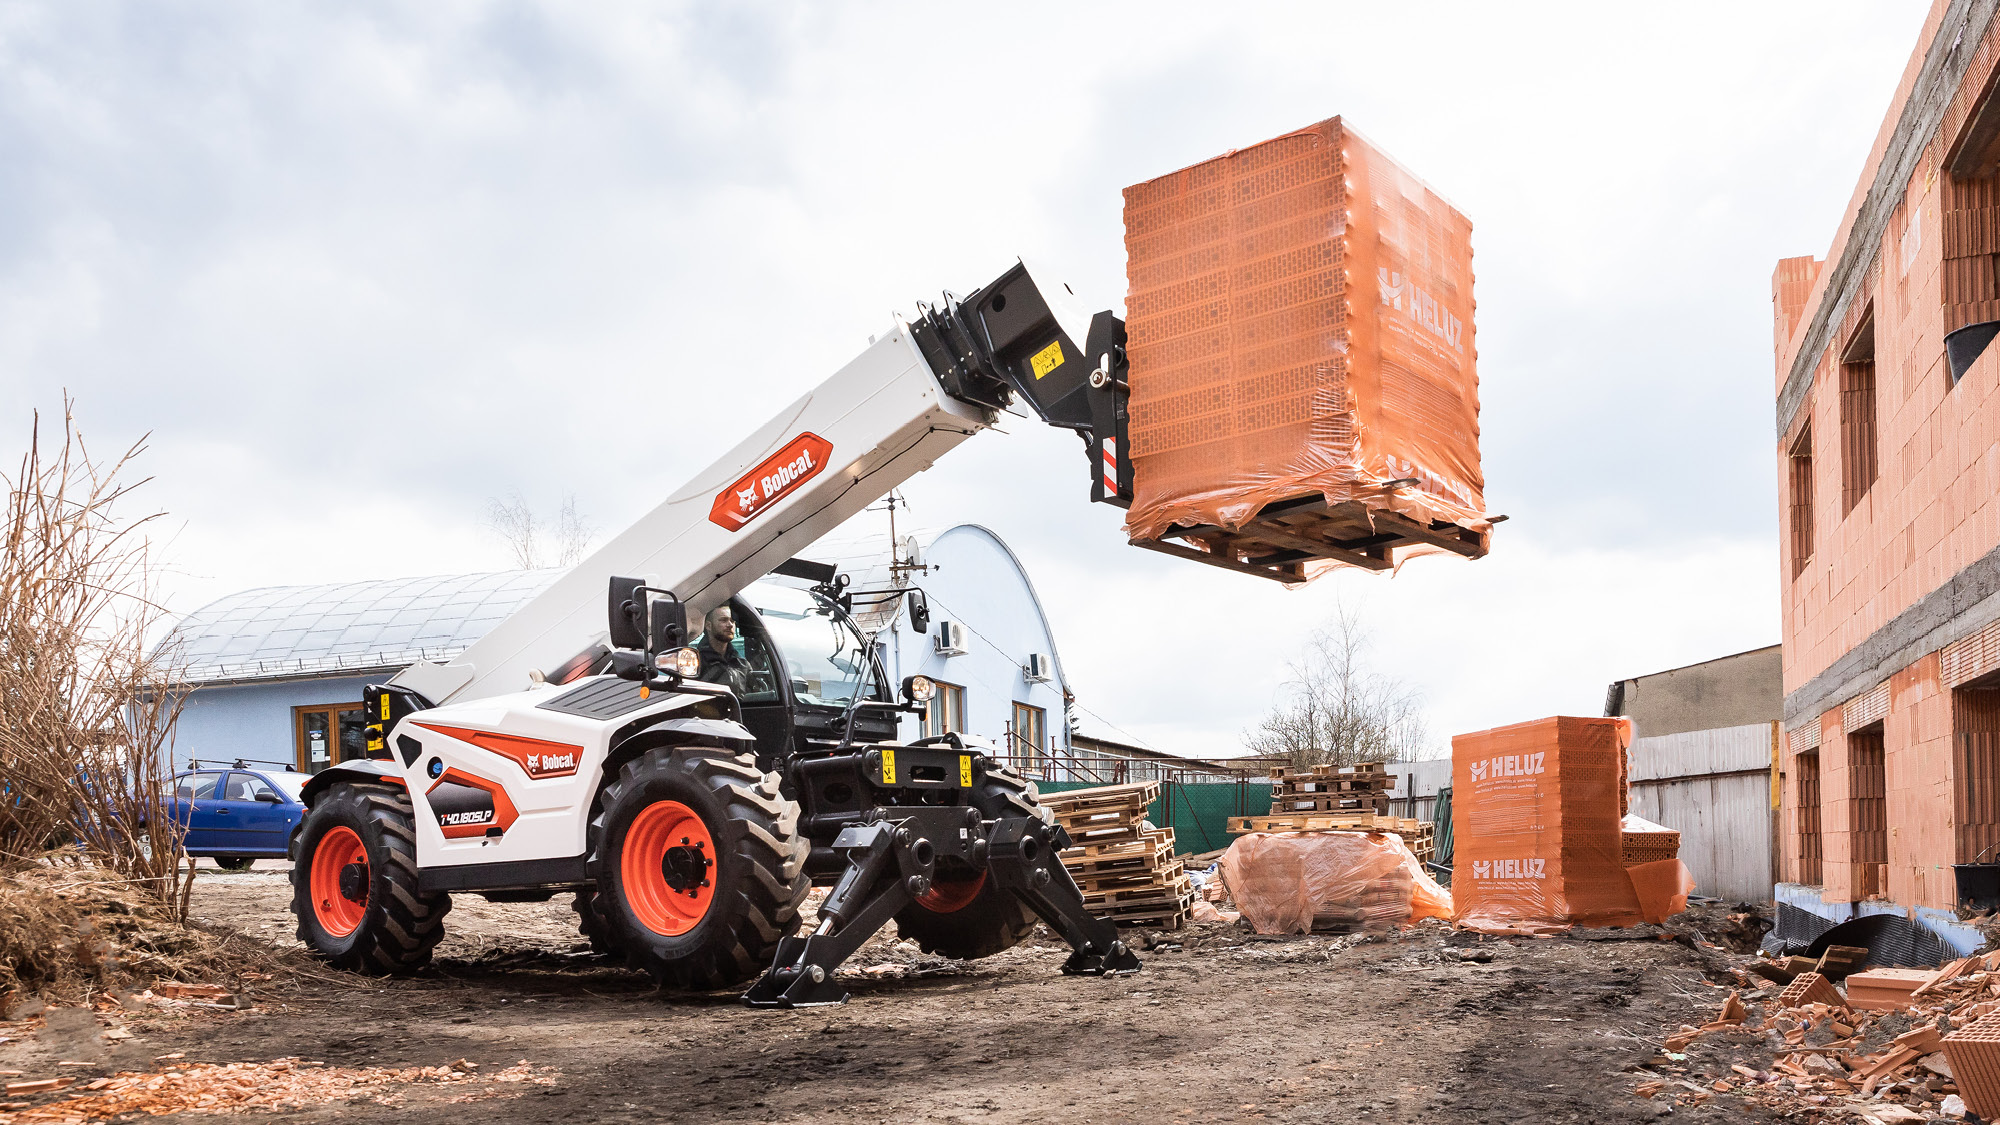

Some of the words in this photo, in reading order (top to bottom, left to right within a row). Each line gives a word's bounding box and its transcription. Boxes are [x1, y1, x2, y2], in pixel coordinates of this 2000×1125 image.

[1408, 281, 1463, 355] HELUZ
[761, 449, 814, 499] Bobcat
[541, 752, 574, 770] Bobcat
[1491, 751, 1545, 778] HELUZ
[1493, 858, 1546, 879] HELUZ
